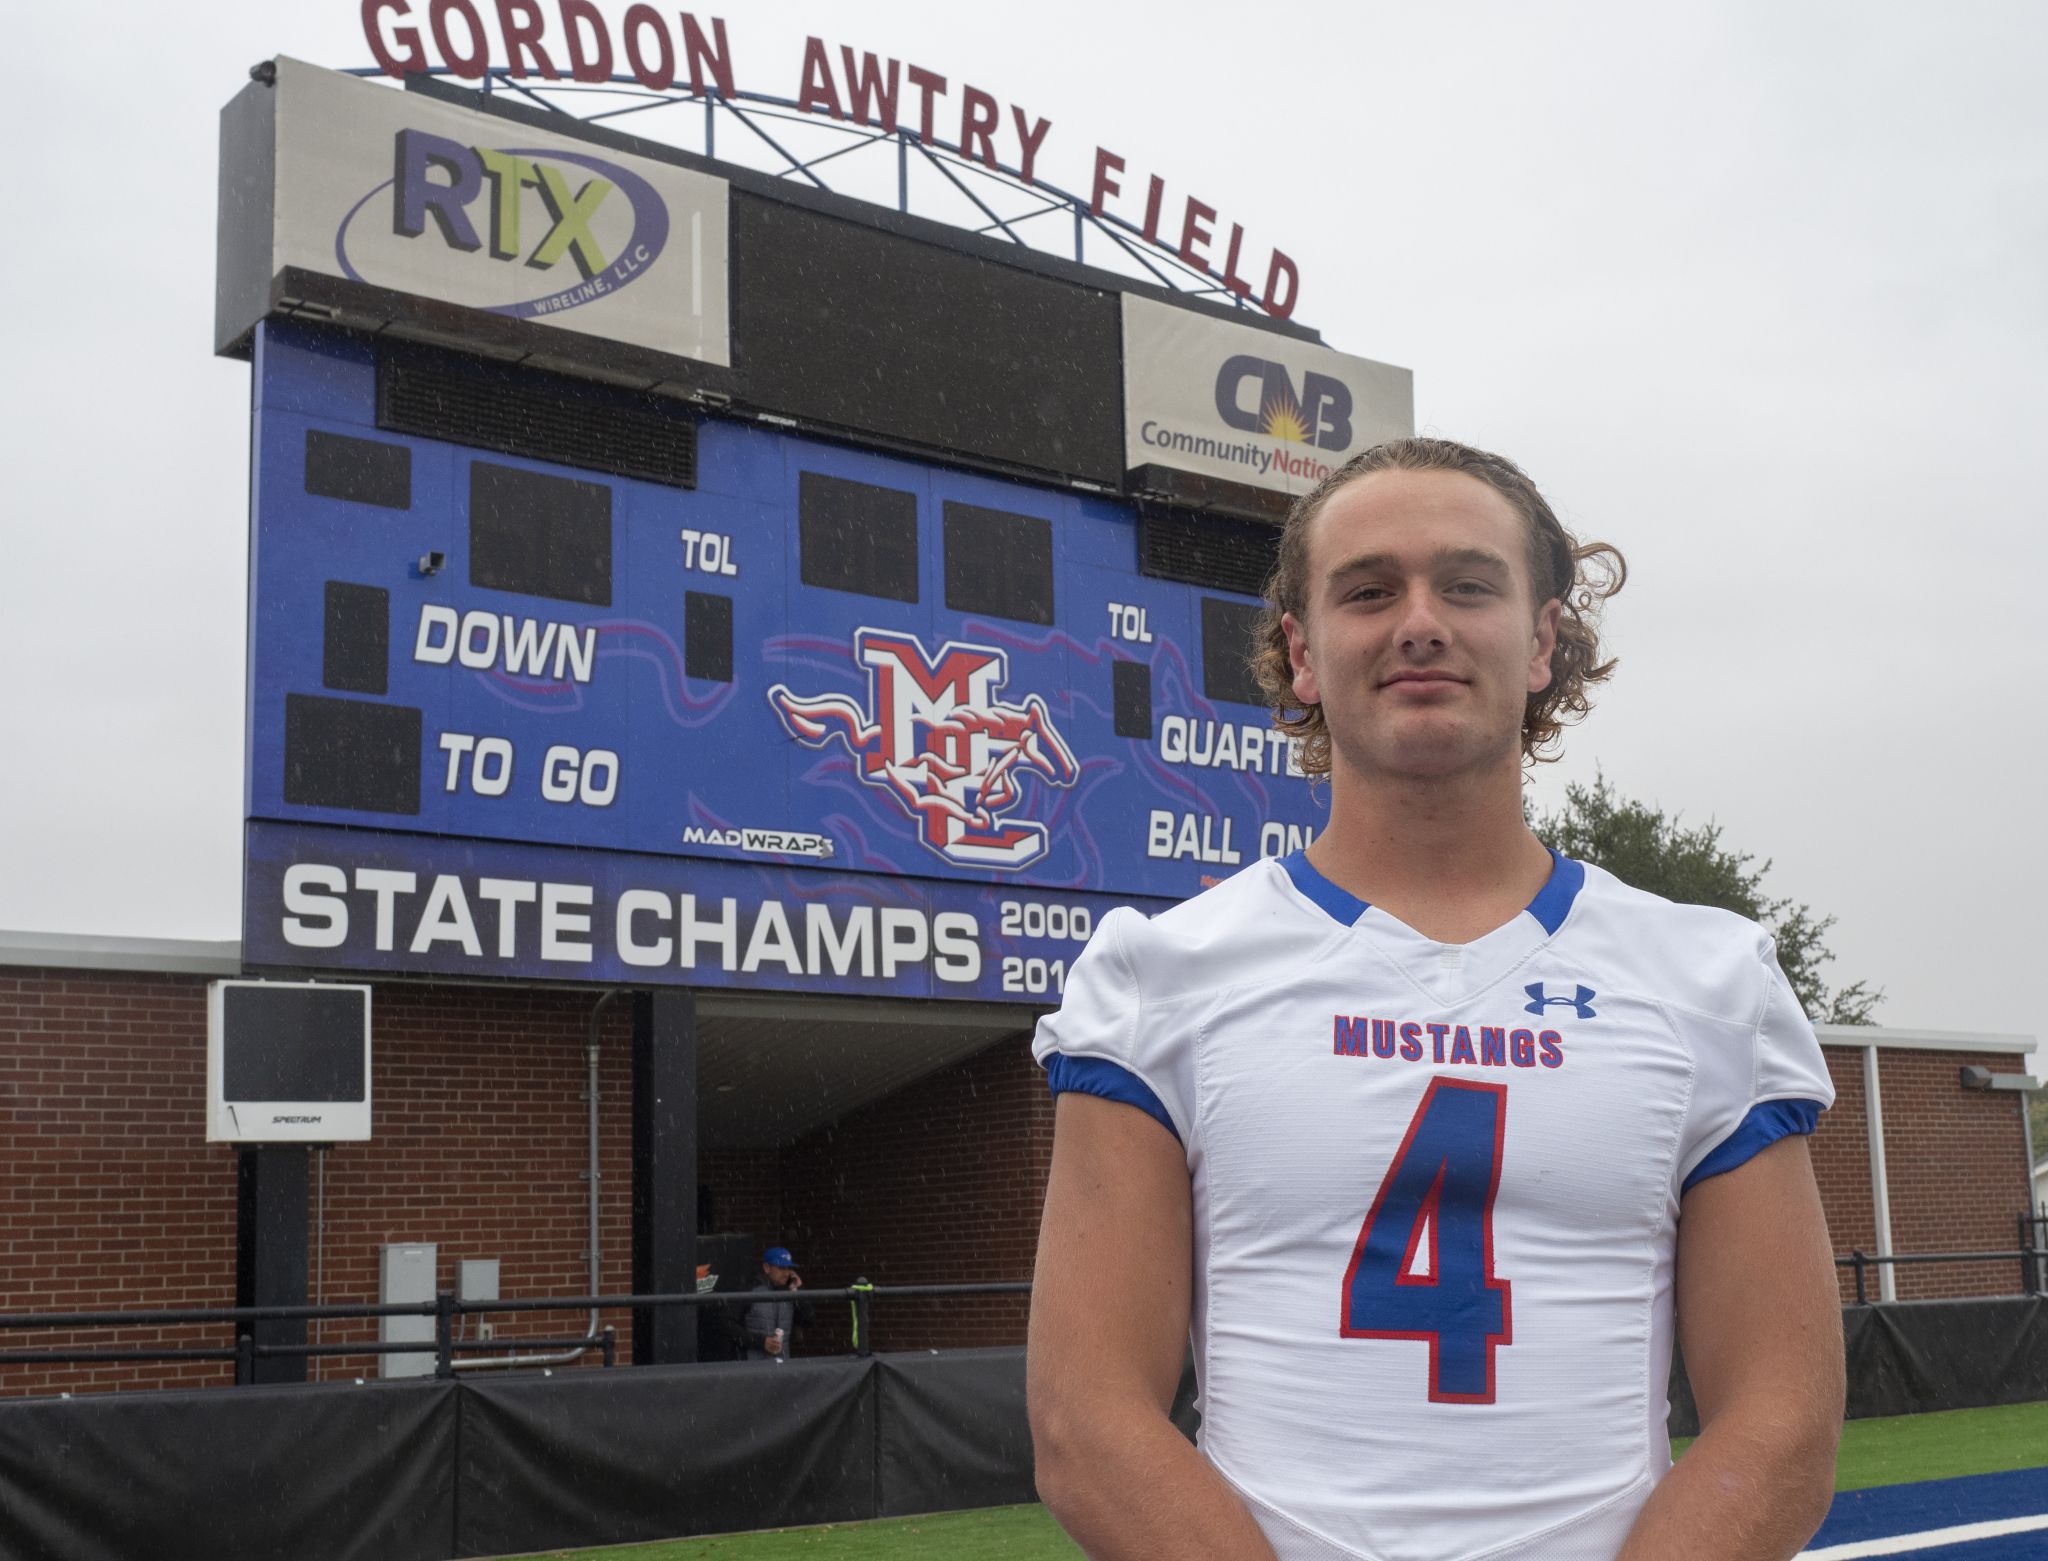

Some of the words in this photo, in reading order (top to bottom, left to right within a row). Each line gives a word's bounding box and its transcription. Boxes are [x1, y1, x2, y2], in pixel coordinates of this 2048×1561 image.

[361, 0, 737, 99] GORDON
[797, 36, 1052, 187] AWTRY
[1090, 146, 1300, 321] FIELD
[394, 129, 614, 281] RTX
[533, 278, 613, 314] WIRELINE,
[614, 244, 650, 280] LLC
[1215, 354, 1353, 452] CNB
[681, 529, 738, 576] TOL
[414, 604, 596, 683] DOWN
[1107, 602, 1153, 643] TOL
[439, 732, 514, 796] TO
[541, 745, 620, 807] GO
[1160, 715, 1331, 779] QUARTE
[1148, 810, 1240, 864] BALL
[282, 863, 594, 963] STATE
[616, 889, 982, 984] CHAMPS
[1002, 957, 1065, 995] 201
[1333, 1015, 1564, 1068] MUSTANGS
[1340, 1076, 1512, 1405] 4
